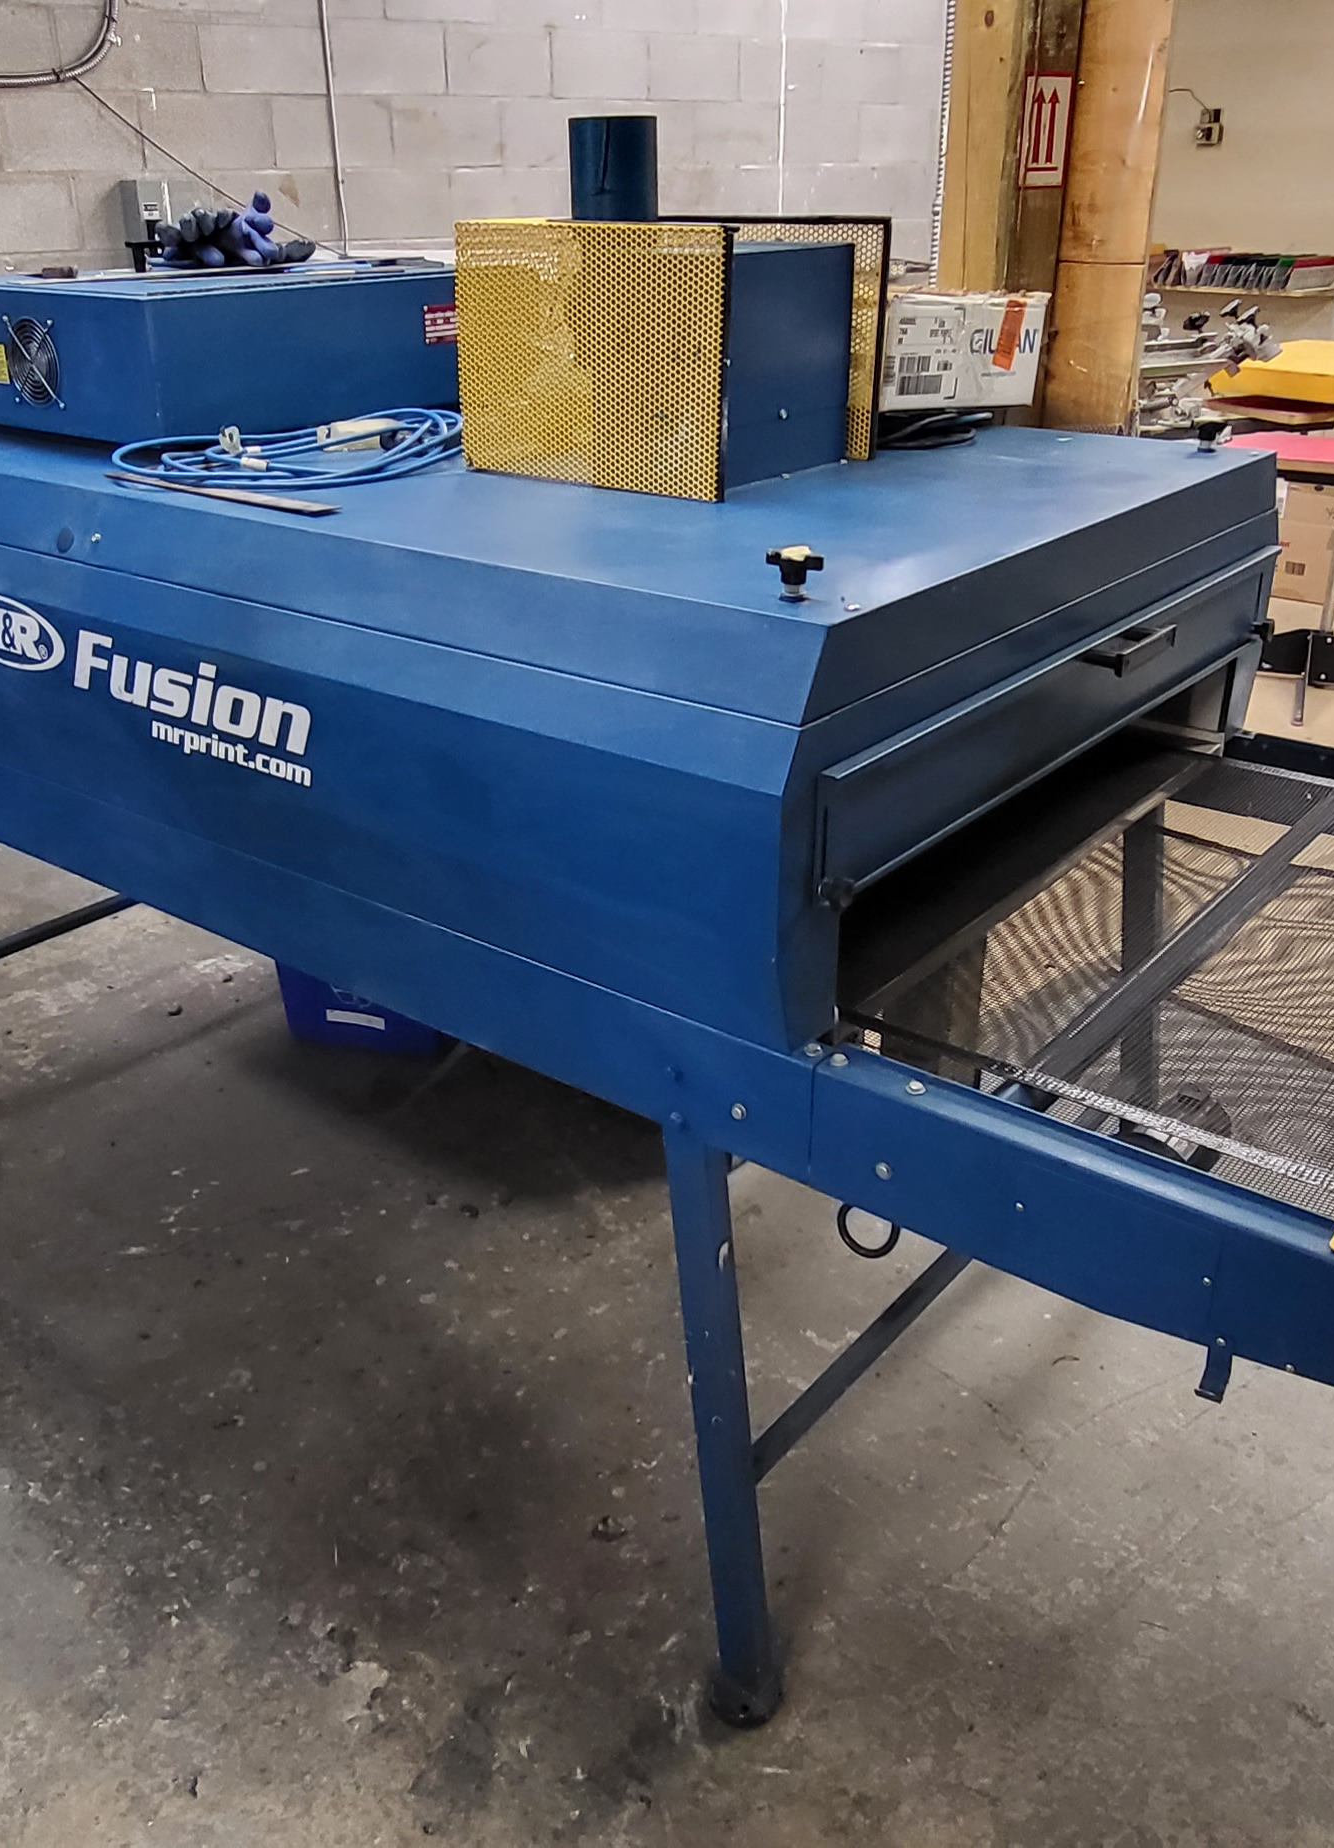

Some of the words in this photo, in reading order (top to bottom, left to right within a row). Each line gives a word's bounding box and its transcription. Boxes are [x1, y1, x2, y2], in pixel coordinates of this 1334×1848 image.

[970, 328, 1037, 355] GILAN
[73, 629, 312, 755] Fusion
[152, 719, 312, 787] mrprint.com
